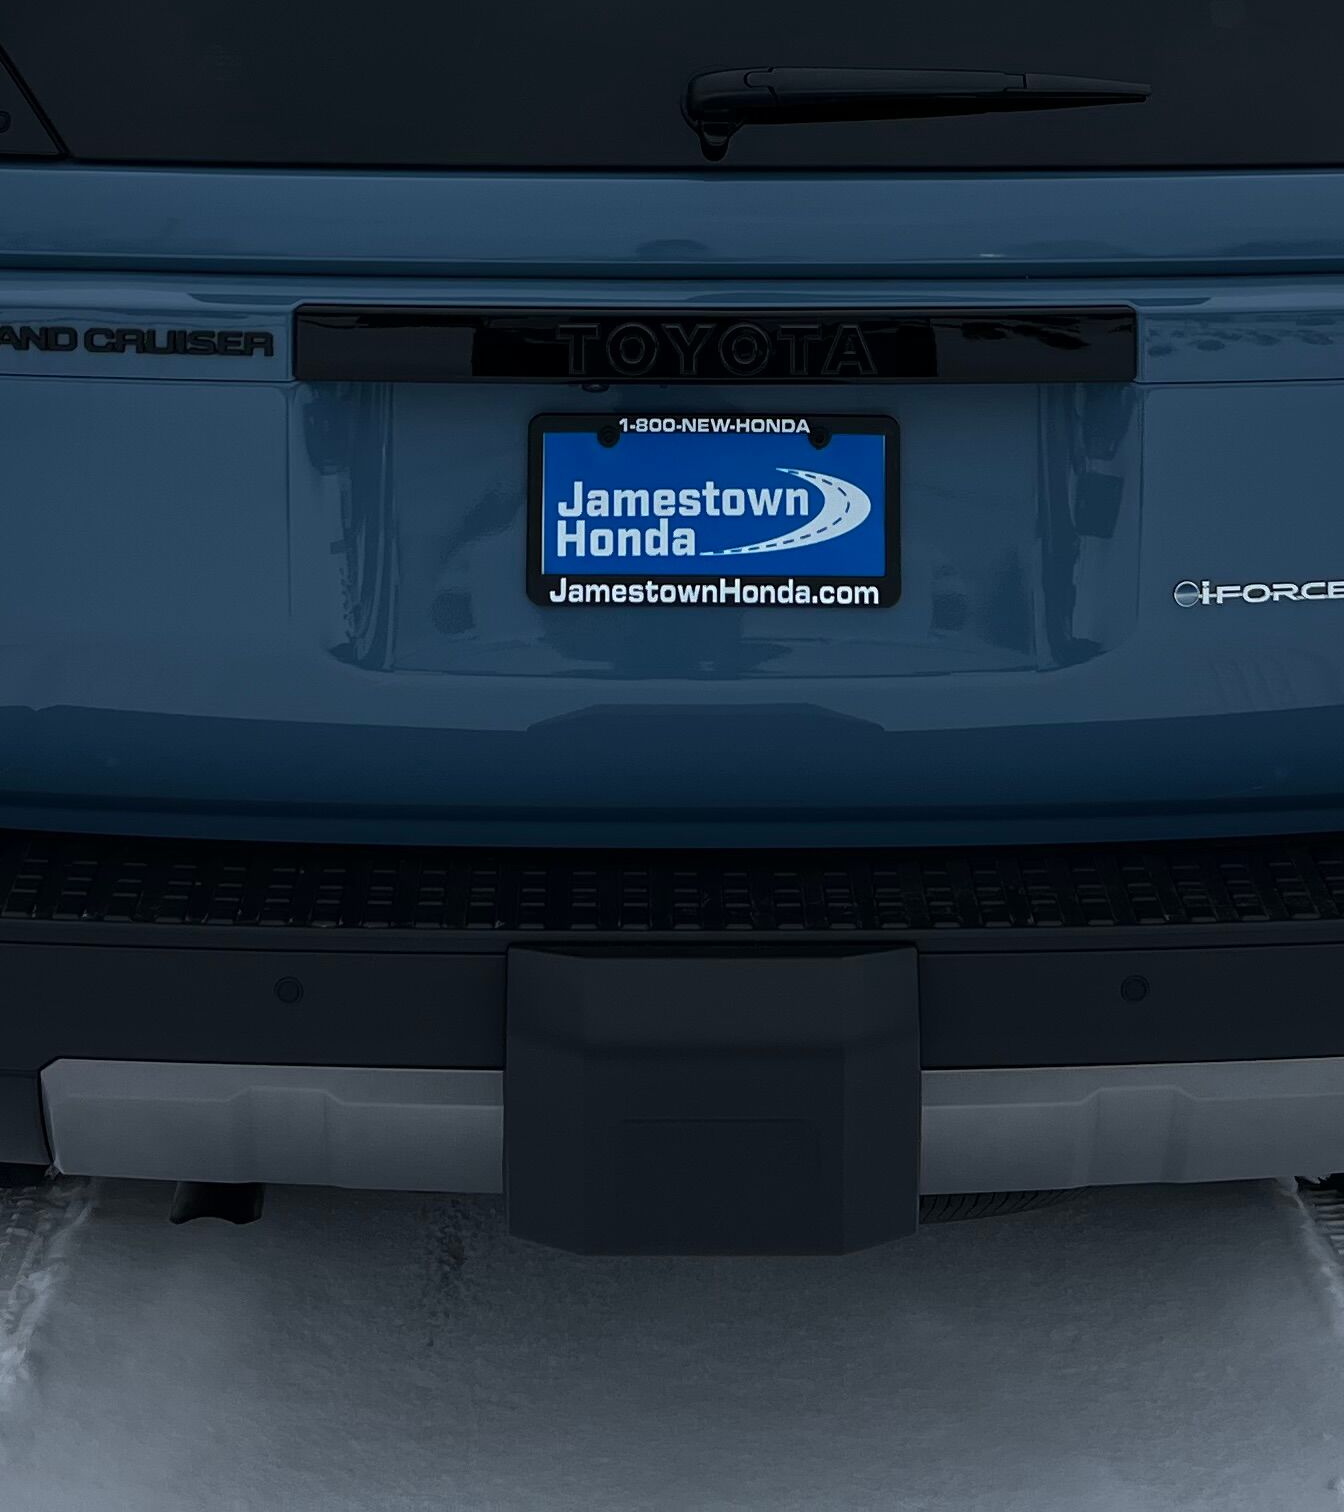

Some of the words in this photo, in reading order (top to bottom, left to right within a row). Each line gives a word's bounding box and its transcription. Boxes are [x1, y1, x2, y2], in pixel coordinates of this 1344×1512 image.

[84, 327, 275, 357] CRUISER
[556, 322, 878, 376] TOYOTA
[618, 417, 811, 434] 1-800-NEW-HONDA
[557, 480, 810, 517] Jamestown
[557, 518, 697, 558] Honda
[549, 577, 880, 605] JamestownHonda.com
